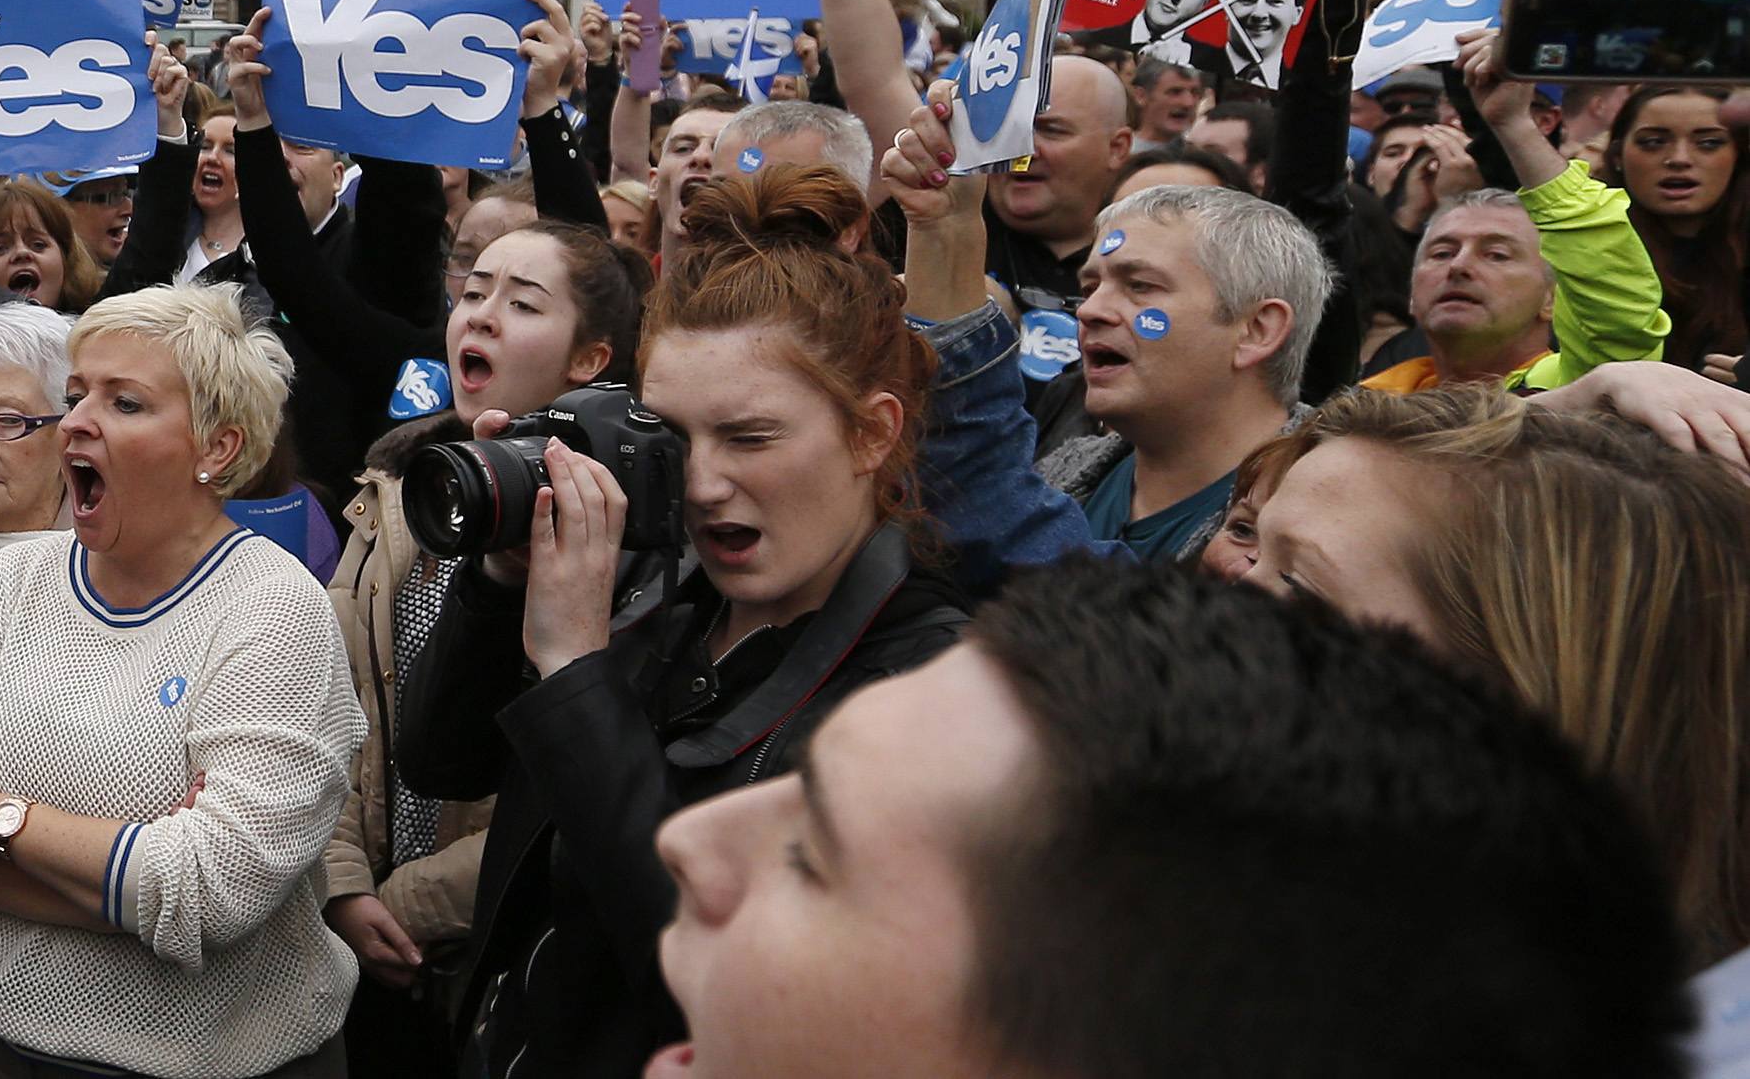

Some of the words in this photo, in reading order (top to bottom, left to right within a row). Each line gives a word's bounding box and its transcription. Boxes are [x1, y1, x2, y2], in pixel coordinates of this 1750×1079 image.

[969, 23, 1021, 96] Yes
[1140, 315, 1166, 331] Yes
[1019, 325, 1082, 363] Yes
[396, 359, 441, 411] Yes
[548, 409, 575, 422] Canon
[620, 445, 635, 454] EOS
